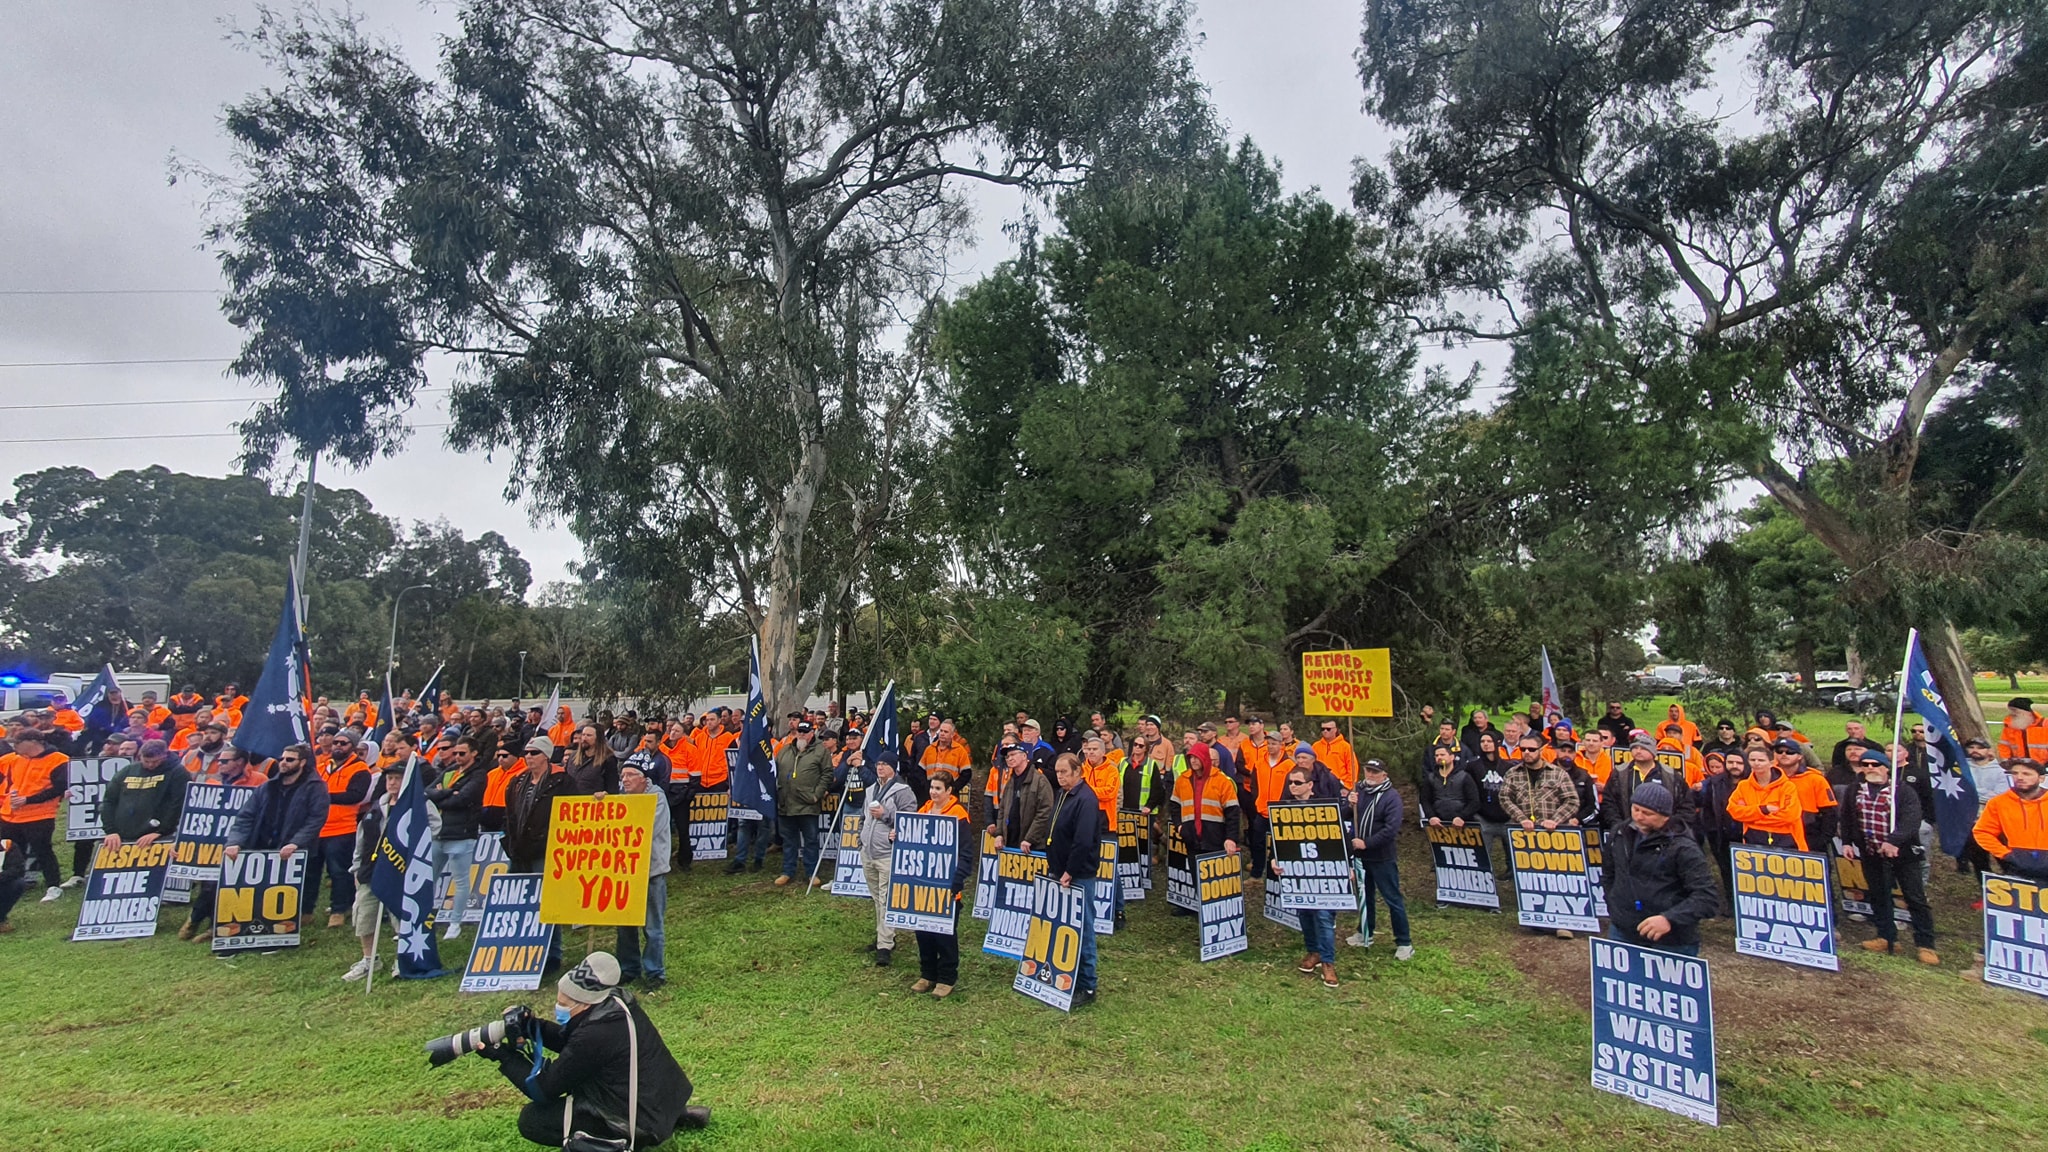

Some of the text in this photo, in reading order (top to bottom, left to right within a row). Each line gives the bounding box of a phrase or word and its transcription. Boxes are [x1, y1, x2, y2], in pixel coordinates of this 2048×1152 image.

[1304, 653, 1363, 670] RETIRED
[1309, 682, 1370, 700] SUPPORT
[1322, 695, 1354, 713] YOU
[188, 786, 224, 810] SAME
[690, 794, 729, 807] TOOD
[182, 813, 237, 837] LESS PA
[559, 801, 627, 824] RETIRED
[1270, 806, 1338, 823] FORCED
[898, 816, 929, 844] SAME
[931, 820, 953, 846] JOB
[1273, 824, 1342, 841] LABOUR
[1426, 826, 1483, 847] RESPECT
[1511, 830, 1581, 851] STOOD
[94, 843, 171, 869] RESPECT
[176, 841, 223, 865] NO WA
[381, 837, 406, 873] SOUTH
[1300, 842, 1318, 859] IS
[1441, 846, 1478, 868] THE
[1514, 851, 1584, 872] DOWN
[224, 852, 305, 885] VOTE
[552, 848, 640, 880] SUPPORT
[836, 866, 866, 882] PA
[894, 849, 924, 876] LESS
[927, 852, 952, 879] PAY
[1199, 855, 1241, 879] STOOD
[1279, 860, 1348, 876] MODERN
[1735, 851, 1823, 880] STOOD
[102, 871, 150, 895] THE
[491, 878, 530, 905] SAME
[1168, 880, 1197, 899] SLAV
[1201, 875, 1242, 901] DOWN
[1282, 879, 1349, 894] SLAVERY
[1437, 867, 1495, 893] WORKERS
[1517, 871, 1587, 894] WITHOUT
[1737, 873, 1825, 903] DOWN
[217, 885, 299, 923] NO
[578, 874, 630, 913] YOU
[891, 882, 910, 910] NO
[914, 885, 951, 915] WAY!
[1005, 882, 1034, 909] THE
[1034, 878, 1083, 928] VOTE
[1283, 895, 1316, 905] S.B.U
[1520, 892, 1589, 915] PAY
[81, 896, 159, 925] WORKERS
[1202, 896, 1243, 923] WITHOUT
[1521, 913, 1556, 923] S.B.U
[1738, 895, 1827, 928] WITHOUT
[481, 910, 519, 938] LESS
[990, 908, 1031, 940] WORKE
[1203, 918, 1244, 945] PAY
[1741, 918, 1828, 950] PAY
[1987, 909, 2048, 946] TH
[1024, 916, 1079, 972] NO
[1739, 939, 1783, 954] S.B.U
[471, 945, 544, 973] NO WAY!
[1596, 943, 1703, 989] NO TWO
[1989, 940, 2048, 978] ATTA
[1602, 977, 1698, 1023] TIERED
[1609, 1012, 1694, 1059] WAGE
[1598, 1043, 1710, 1101] SYSTEM
[1594, 1073, 1649, 1099] S.B.U
